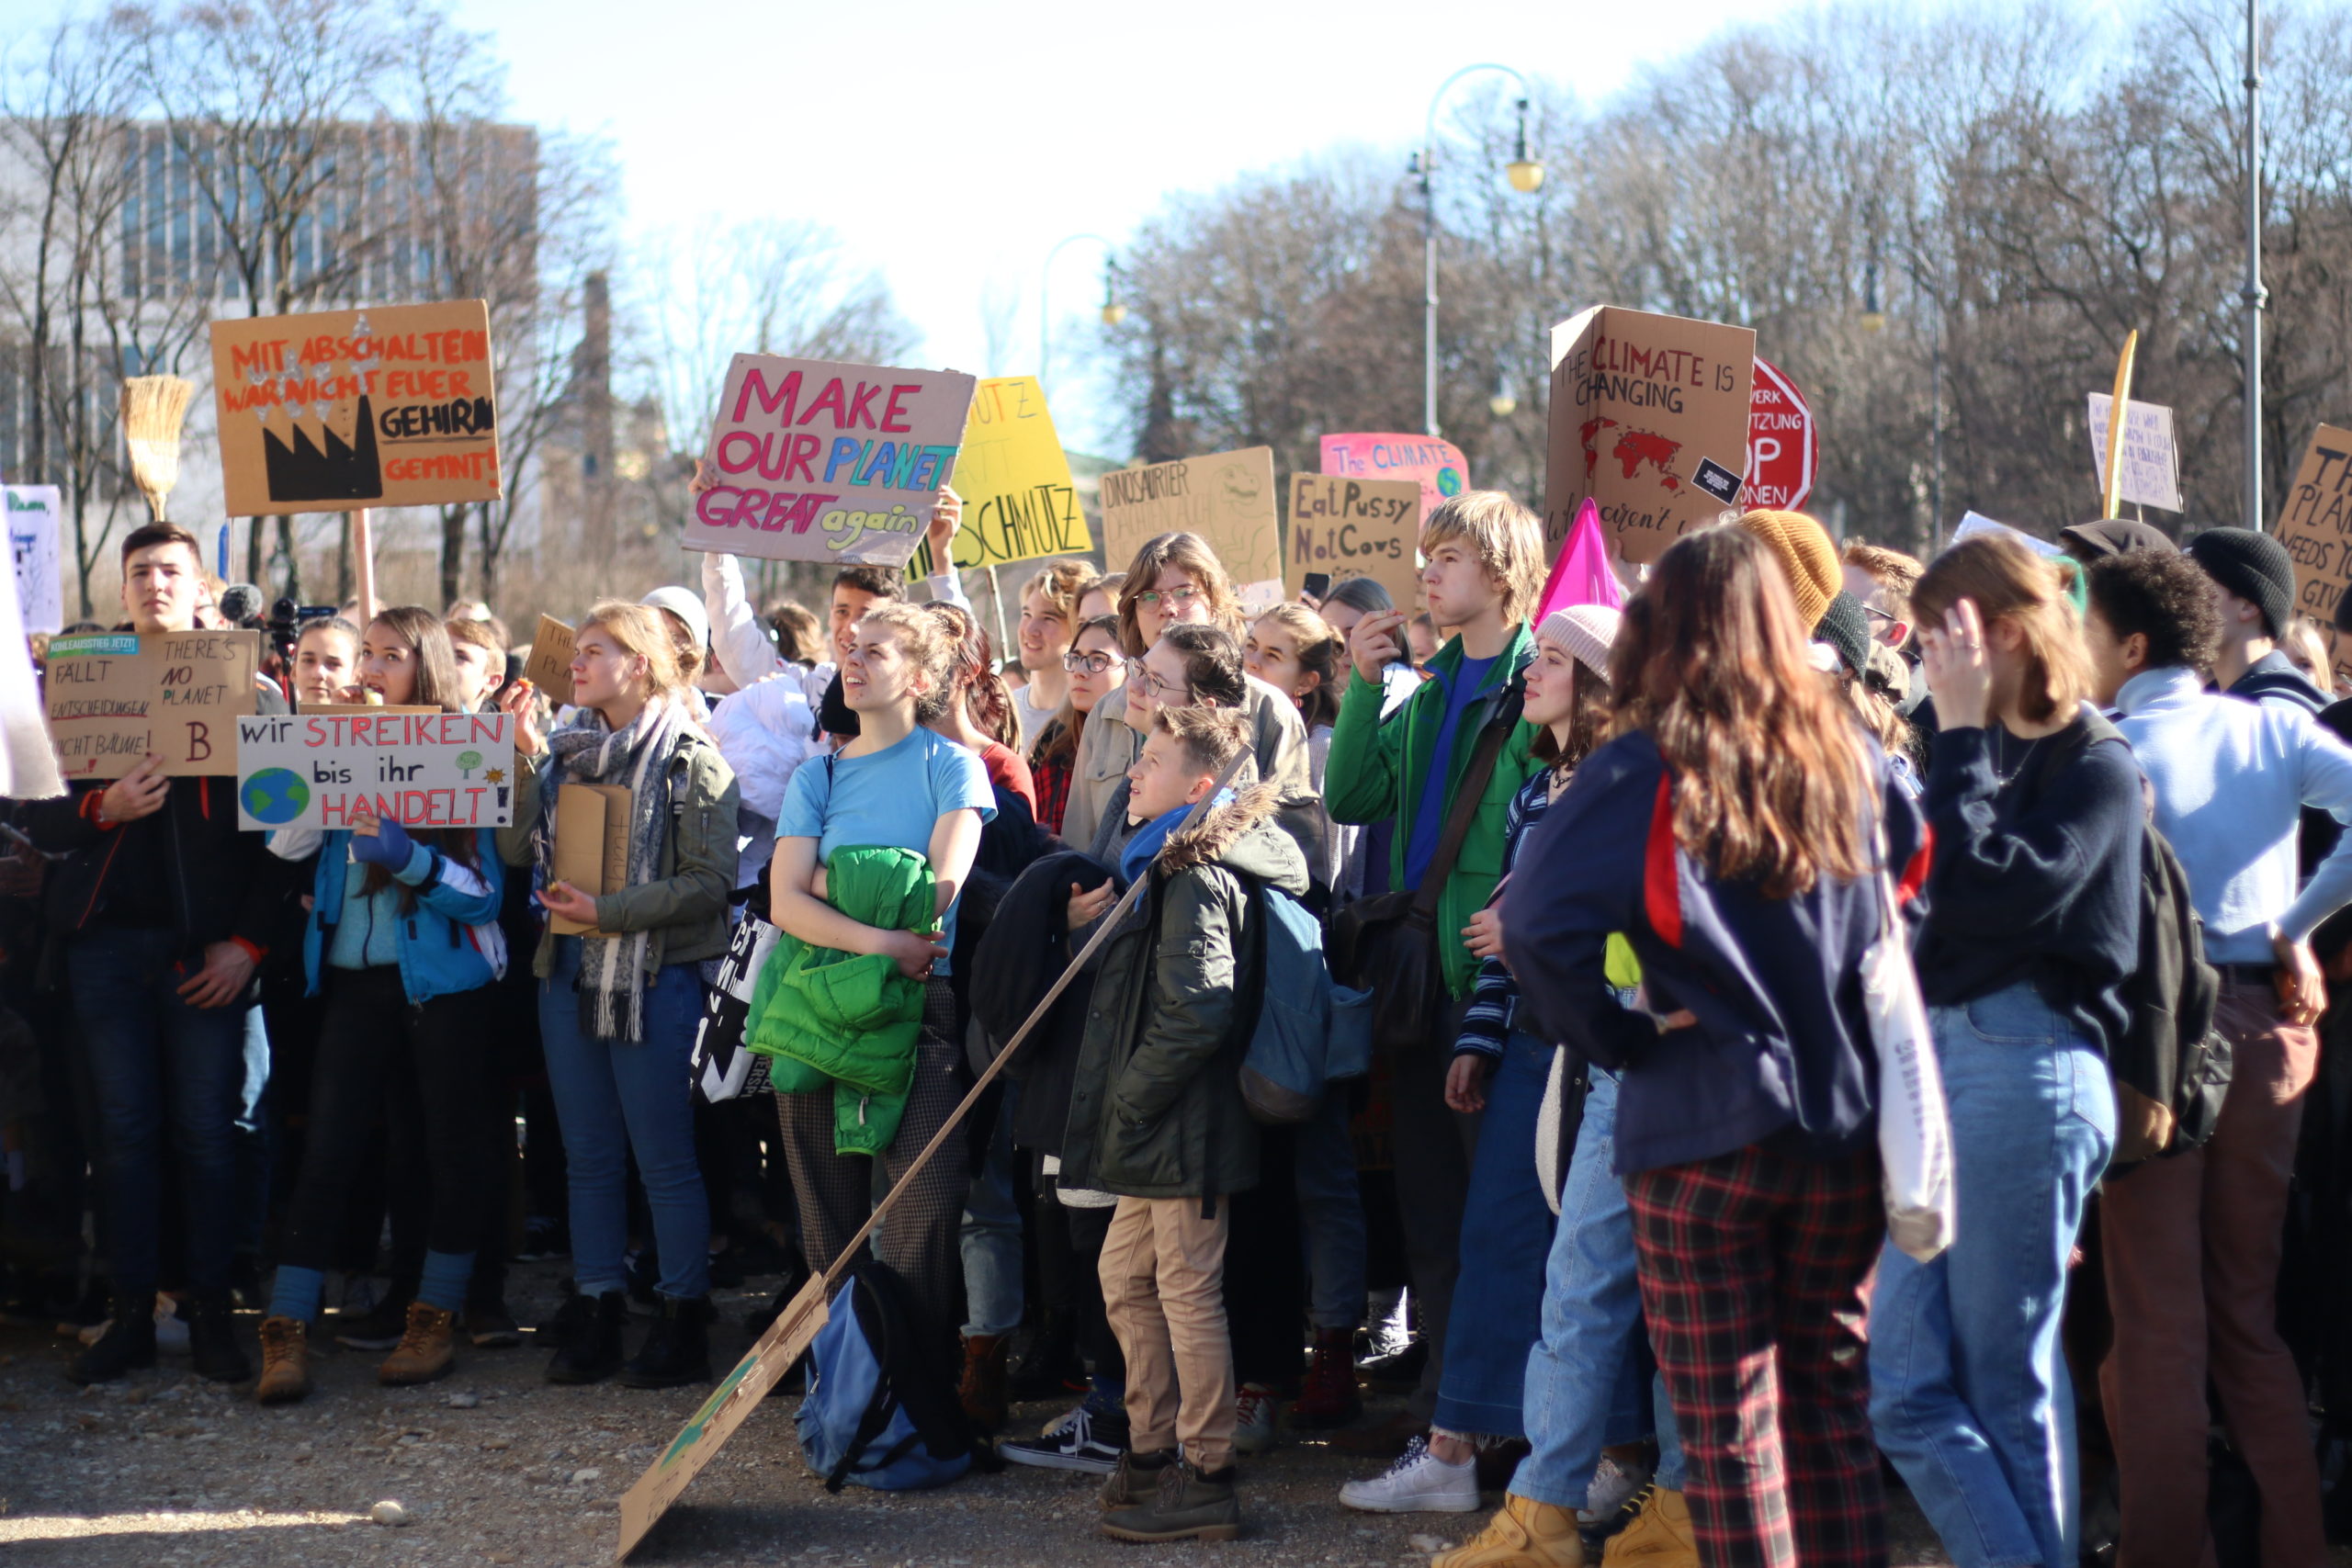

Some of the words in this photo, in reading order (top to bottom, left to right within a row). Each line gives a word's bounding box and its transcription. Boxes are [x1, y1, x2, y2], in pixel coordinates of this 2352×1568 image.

[231, 339, 289, 379] MIT
[299, 330, 487, 366] ABSCHALTEN
[1561, 350, 1588, 388] THE
[1591, 335, 1704, 387] CLIMATE
[1715, 364, 1735, 392] IS
[223, 378, 280, 413] WAR
[283, 369, 380, 405] NICHT
[386, 369, 473, 400] EUER
[731, 367, 922, 433] MAKE
[1576, 372, 1683, 413] CHANGING
[718, 430, 820, 483] OUR
[823, 436, 961, 491] PLANET
[1332, 446, 1365, 473] The
[1373, 444, 1454, 469] CLIMATE
[1104, 462, 1191, 508] DINOSAURIER
[1295, 479, 1340, 519] Eat
[1342, 481, 1412, 525] Pussy
[695, 485, 840, 535] GREAT
[820, 504, 918, 550] again
[1295, 525, 1338, 564] Not
[164, 637, 236, 662] THERE'S
[55, 660, 112, 684] FÄLLT
[161, 665, 193, 685] NO
[51, 699, 150, 719] ENTSCHEIDUNGEN
[163, 684, 227, 706] PLANET
[96, 729, 152, 758] BÄUME!
[186, 721, 211, 762] B
[304, 716, 504, 747] STREIKEN
[313, 760, 352, 784] bis
[379, 754, 424, 783] ihr
